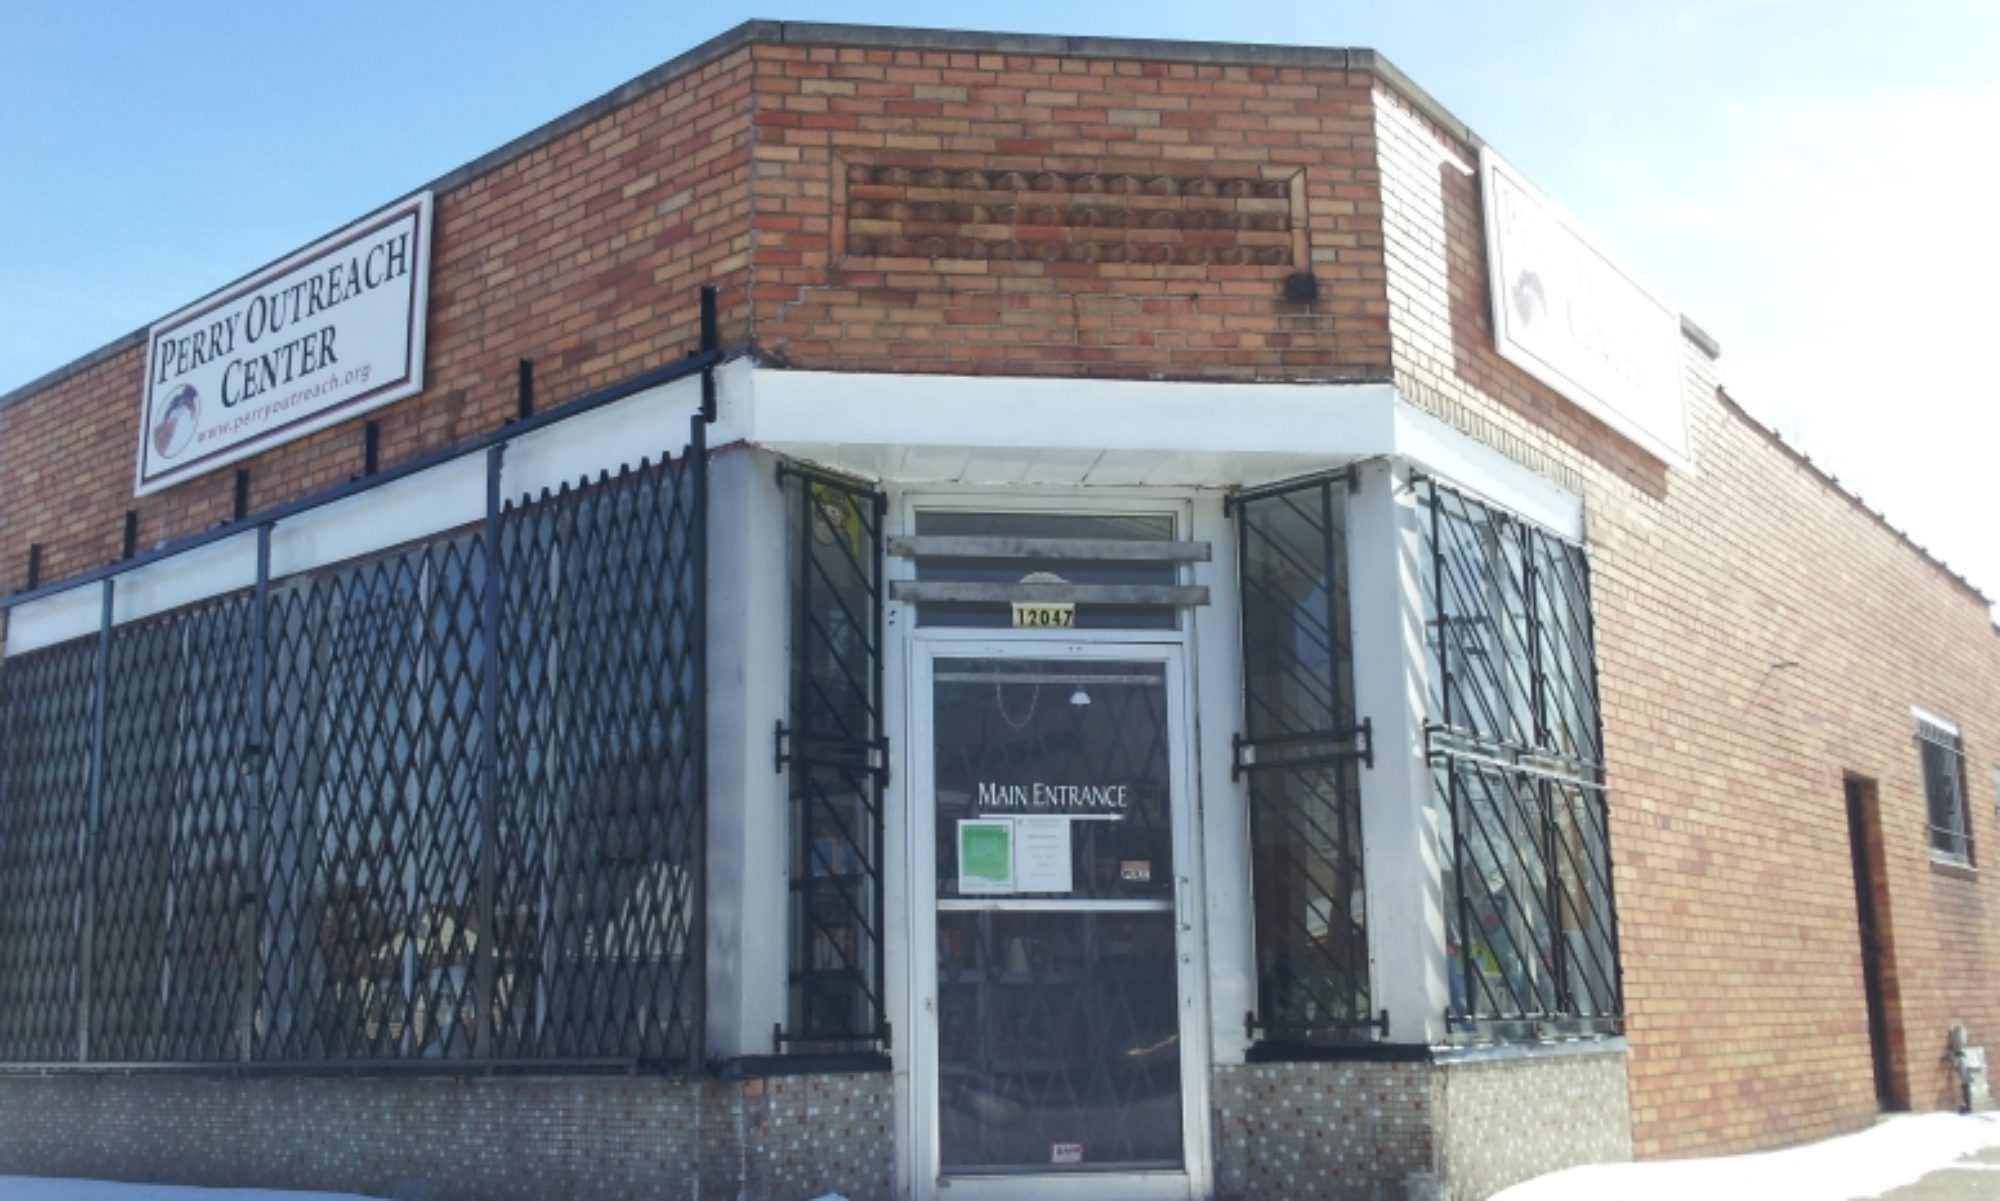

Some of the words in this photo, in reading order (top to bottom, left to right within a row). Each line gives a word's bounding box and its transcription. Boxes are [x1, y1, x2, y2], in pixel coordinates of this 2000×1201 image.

[157, 313, 241, 385] PERRY
[245, 232, 410, 344] OUTREACH
[198, 364, 371, 442] www.perryoutreach.org
[221, 324, 338, 409] CENTER
[1017, 609, 1074, 627] 12047
[978, 781, 1027, 806] MAIN
[1032, 782, 1127, 808] ENTRANCE
